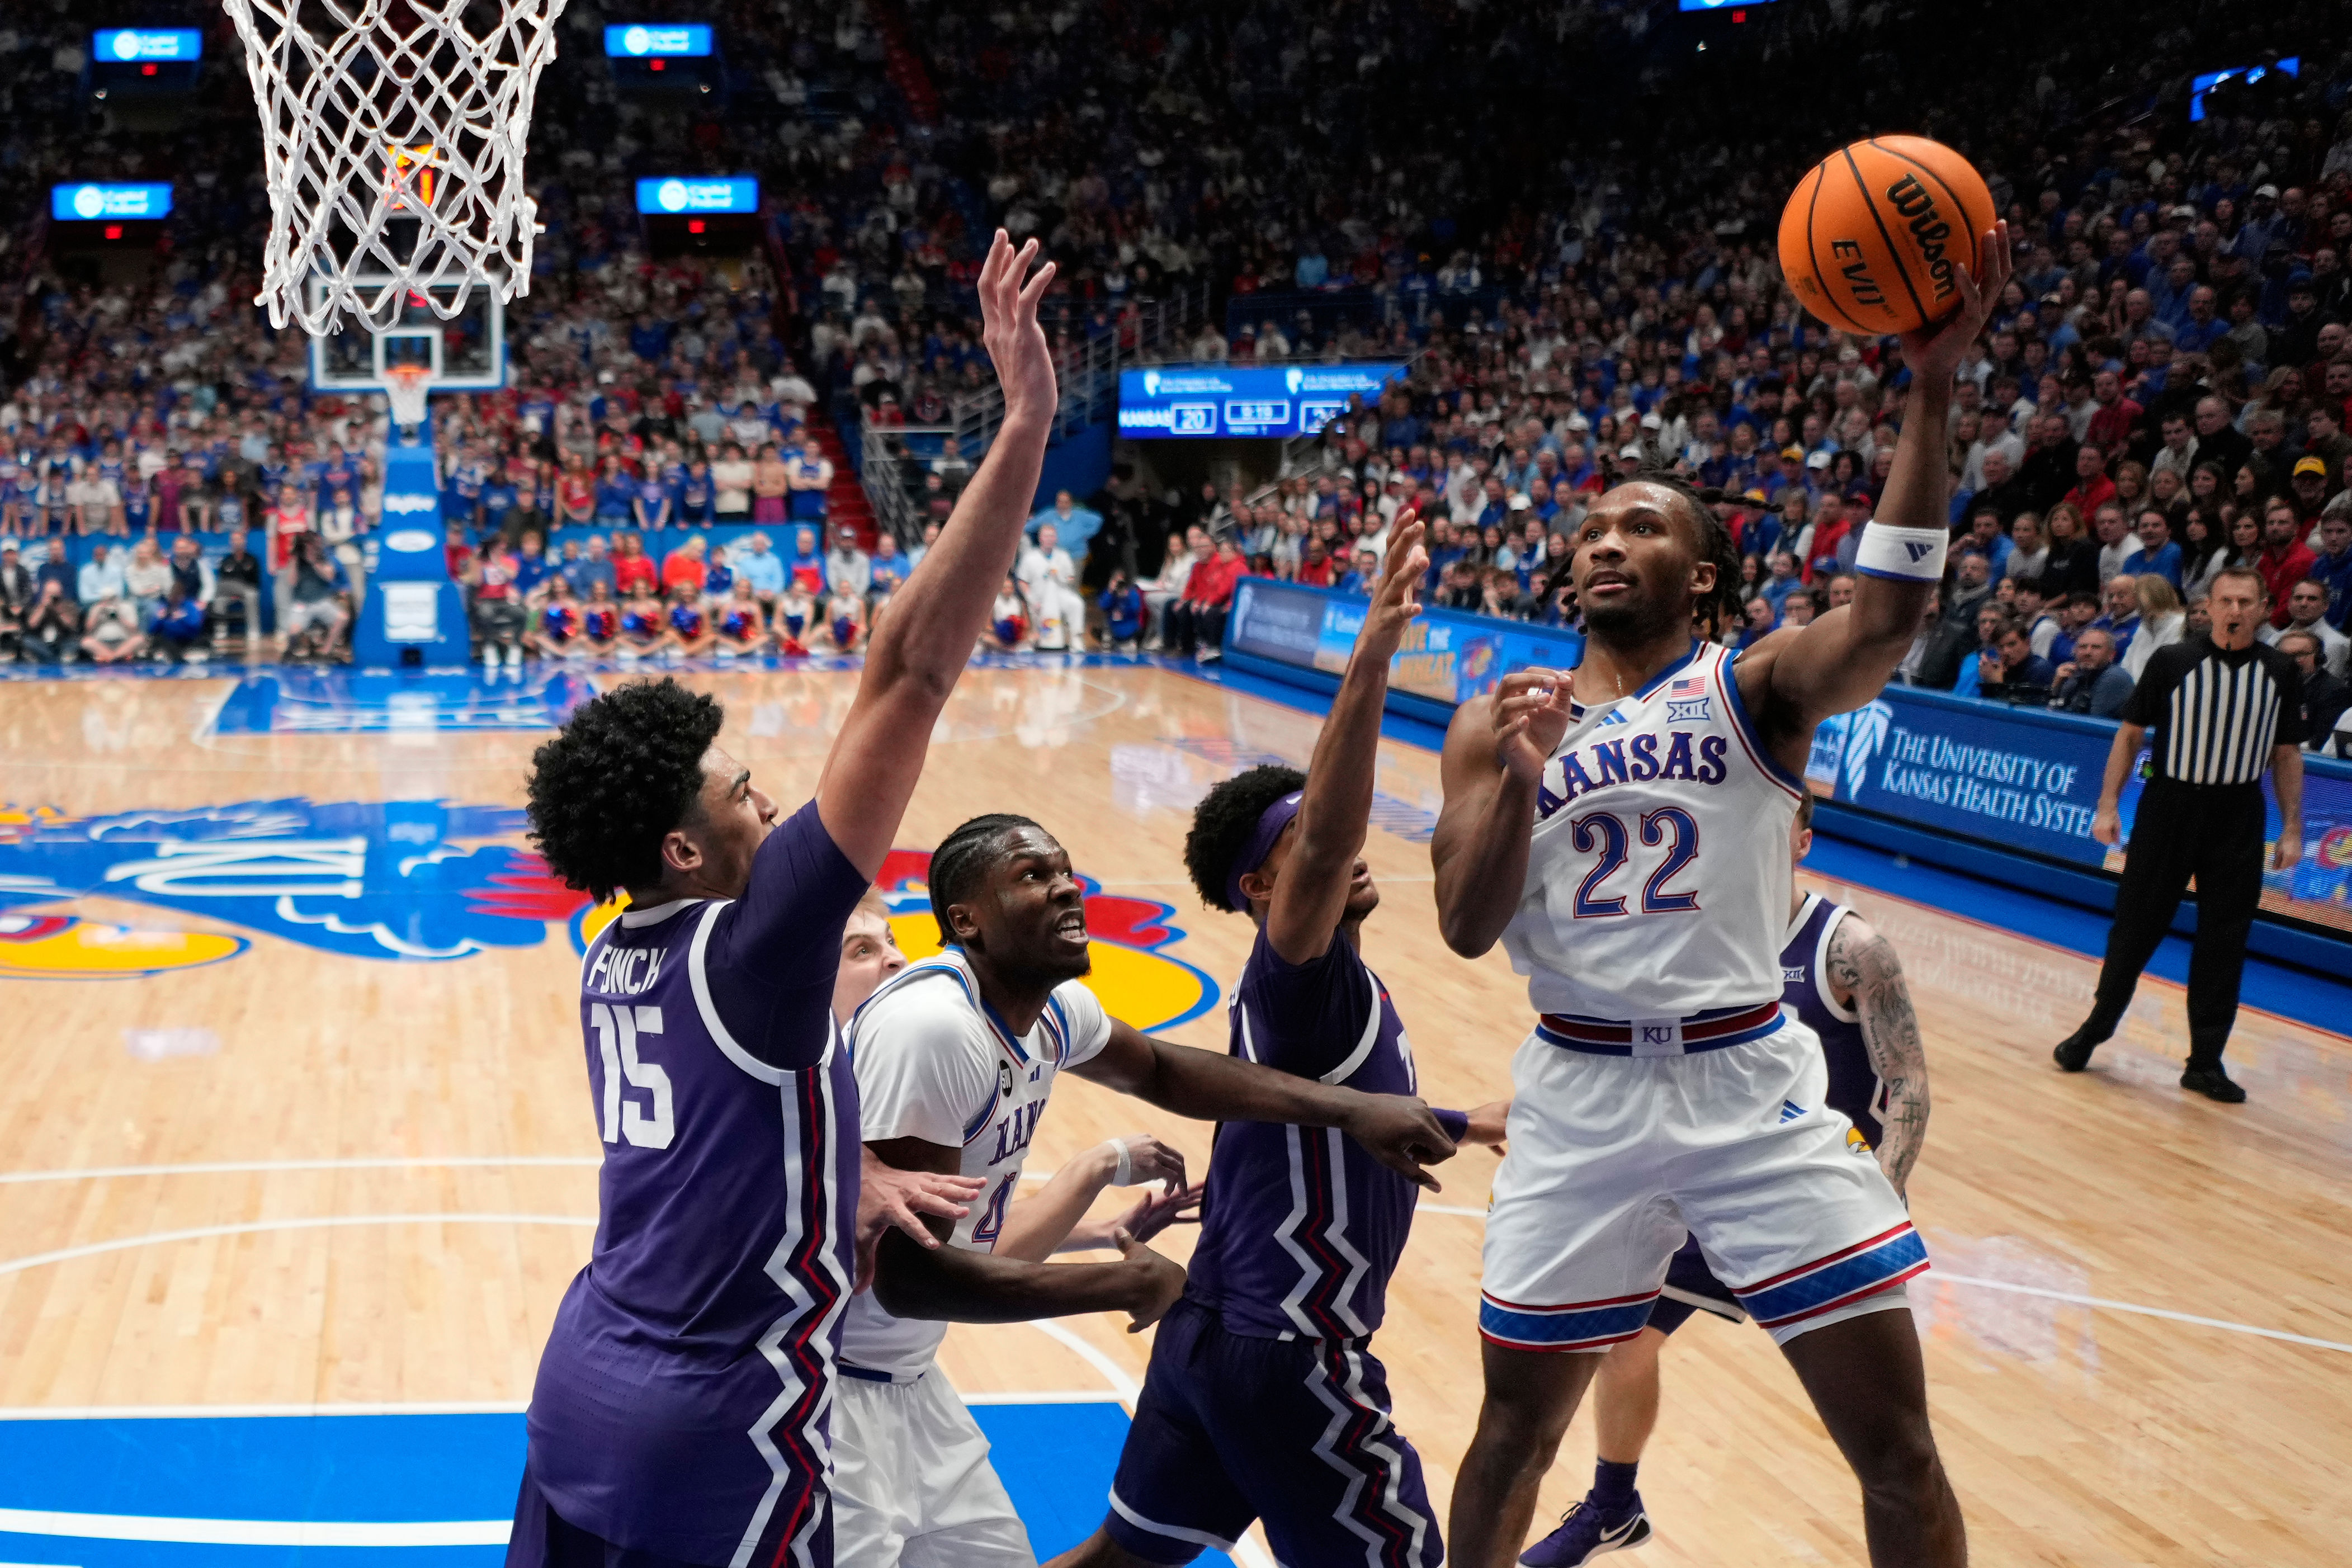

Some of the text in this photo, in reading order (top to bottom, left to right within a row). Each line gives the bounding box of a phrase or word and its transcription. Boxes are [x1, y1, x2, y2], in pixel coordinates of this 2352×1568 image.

[1886, 172, 1956, 304] Wilson
[1118, 408, 1171, 427] KANSAS
[1180, 409, 1206, 429] 20
[1666, 697, 1711, 724] XII
[1882, 759, 1953, 805] KANSAS
[1950, 774, 2032, 824] HEALTH
[1892, 727, 2078, 796] THE UNIVERSITY OF
[1570, 806, 1701, 919] 22
[587, 944, 668, 995] FINCH
[1642, 1027, 1673, 1045] KU
[591, 1002, 676, 1150] 15
